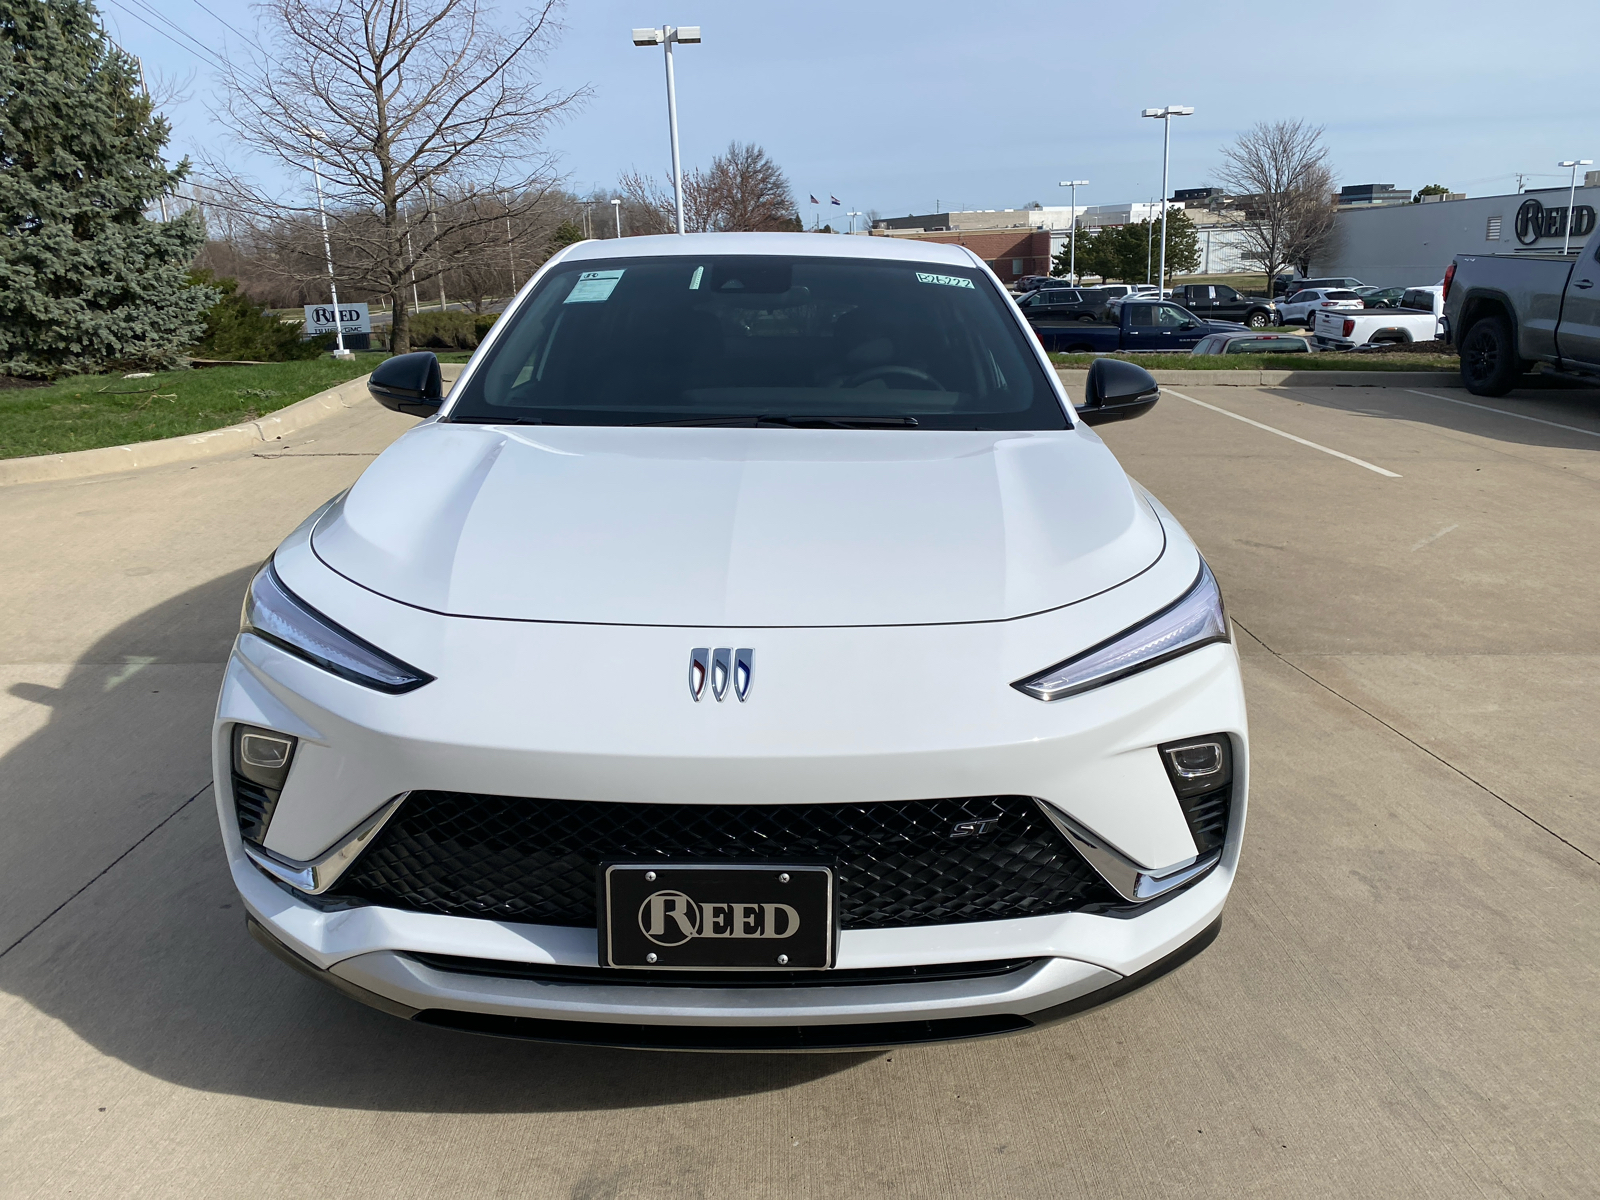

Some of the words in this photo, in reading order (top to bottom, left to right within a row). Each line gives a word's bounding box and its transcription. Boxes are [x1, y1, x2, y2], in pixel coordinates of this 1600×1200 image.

[1515, 199, 1596, 245] REED
[949, 818, 998, 838] ST
[638, 890, 800, 947] REED
